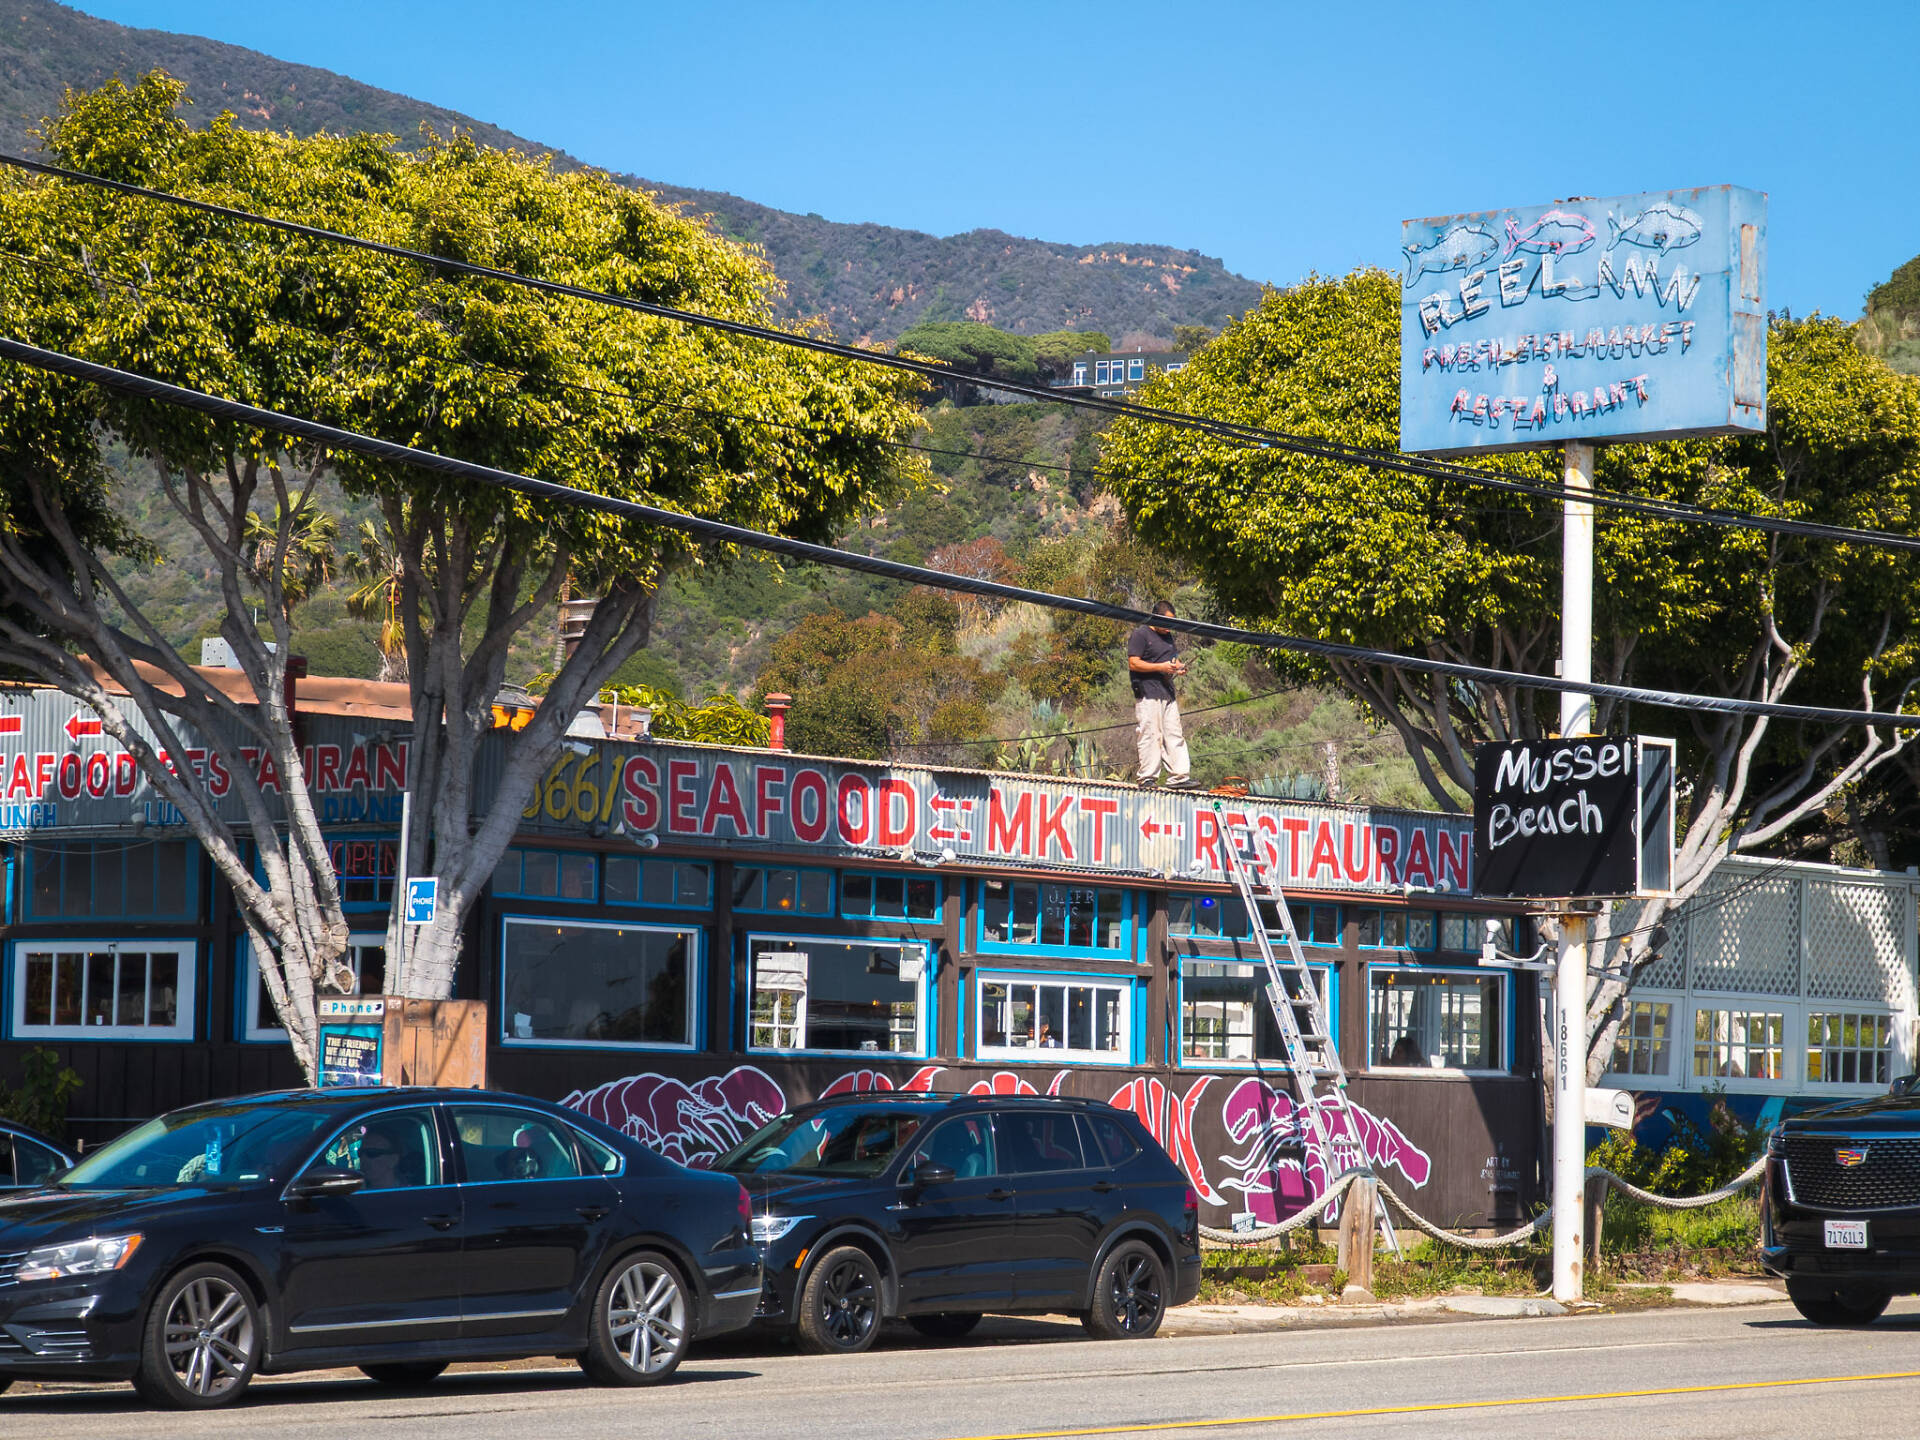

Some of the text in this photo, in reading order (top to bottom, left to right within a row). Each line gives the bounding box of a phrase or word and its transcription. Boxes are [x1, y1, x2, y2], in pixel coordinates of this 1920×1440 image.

[1418, 252, 1580, 339] REEL
[0, 750, 138, 800] AFOOD
[521, 750, 626, 824] 661
[1493, 741, 1632, 795] Mussel
[0, 801, 57, 830] UNCH
[323, 797, 404, 823] DINNE
[622, 754, 1474, 896] SEAFOOD MKT RESTAURAN
[1488, 788, 1604, 851] Beach
[332, 843, 399, 875] OPEN
[412, 897, 433, 906] PHONE
[331, 1002, 372, 1013] Phone
[325, 1046, 338, 1056] WE
[326, 1036, 377, 1051] THE FRIENDS
[1560, 1008, 1568, 1091] 18661
[1827, 1230, 1864, 1244] 71761L3
